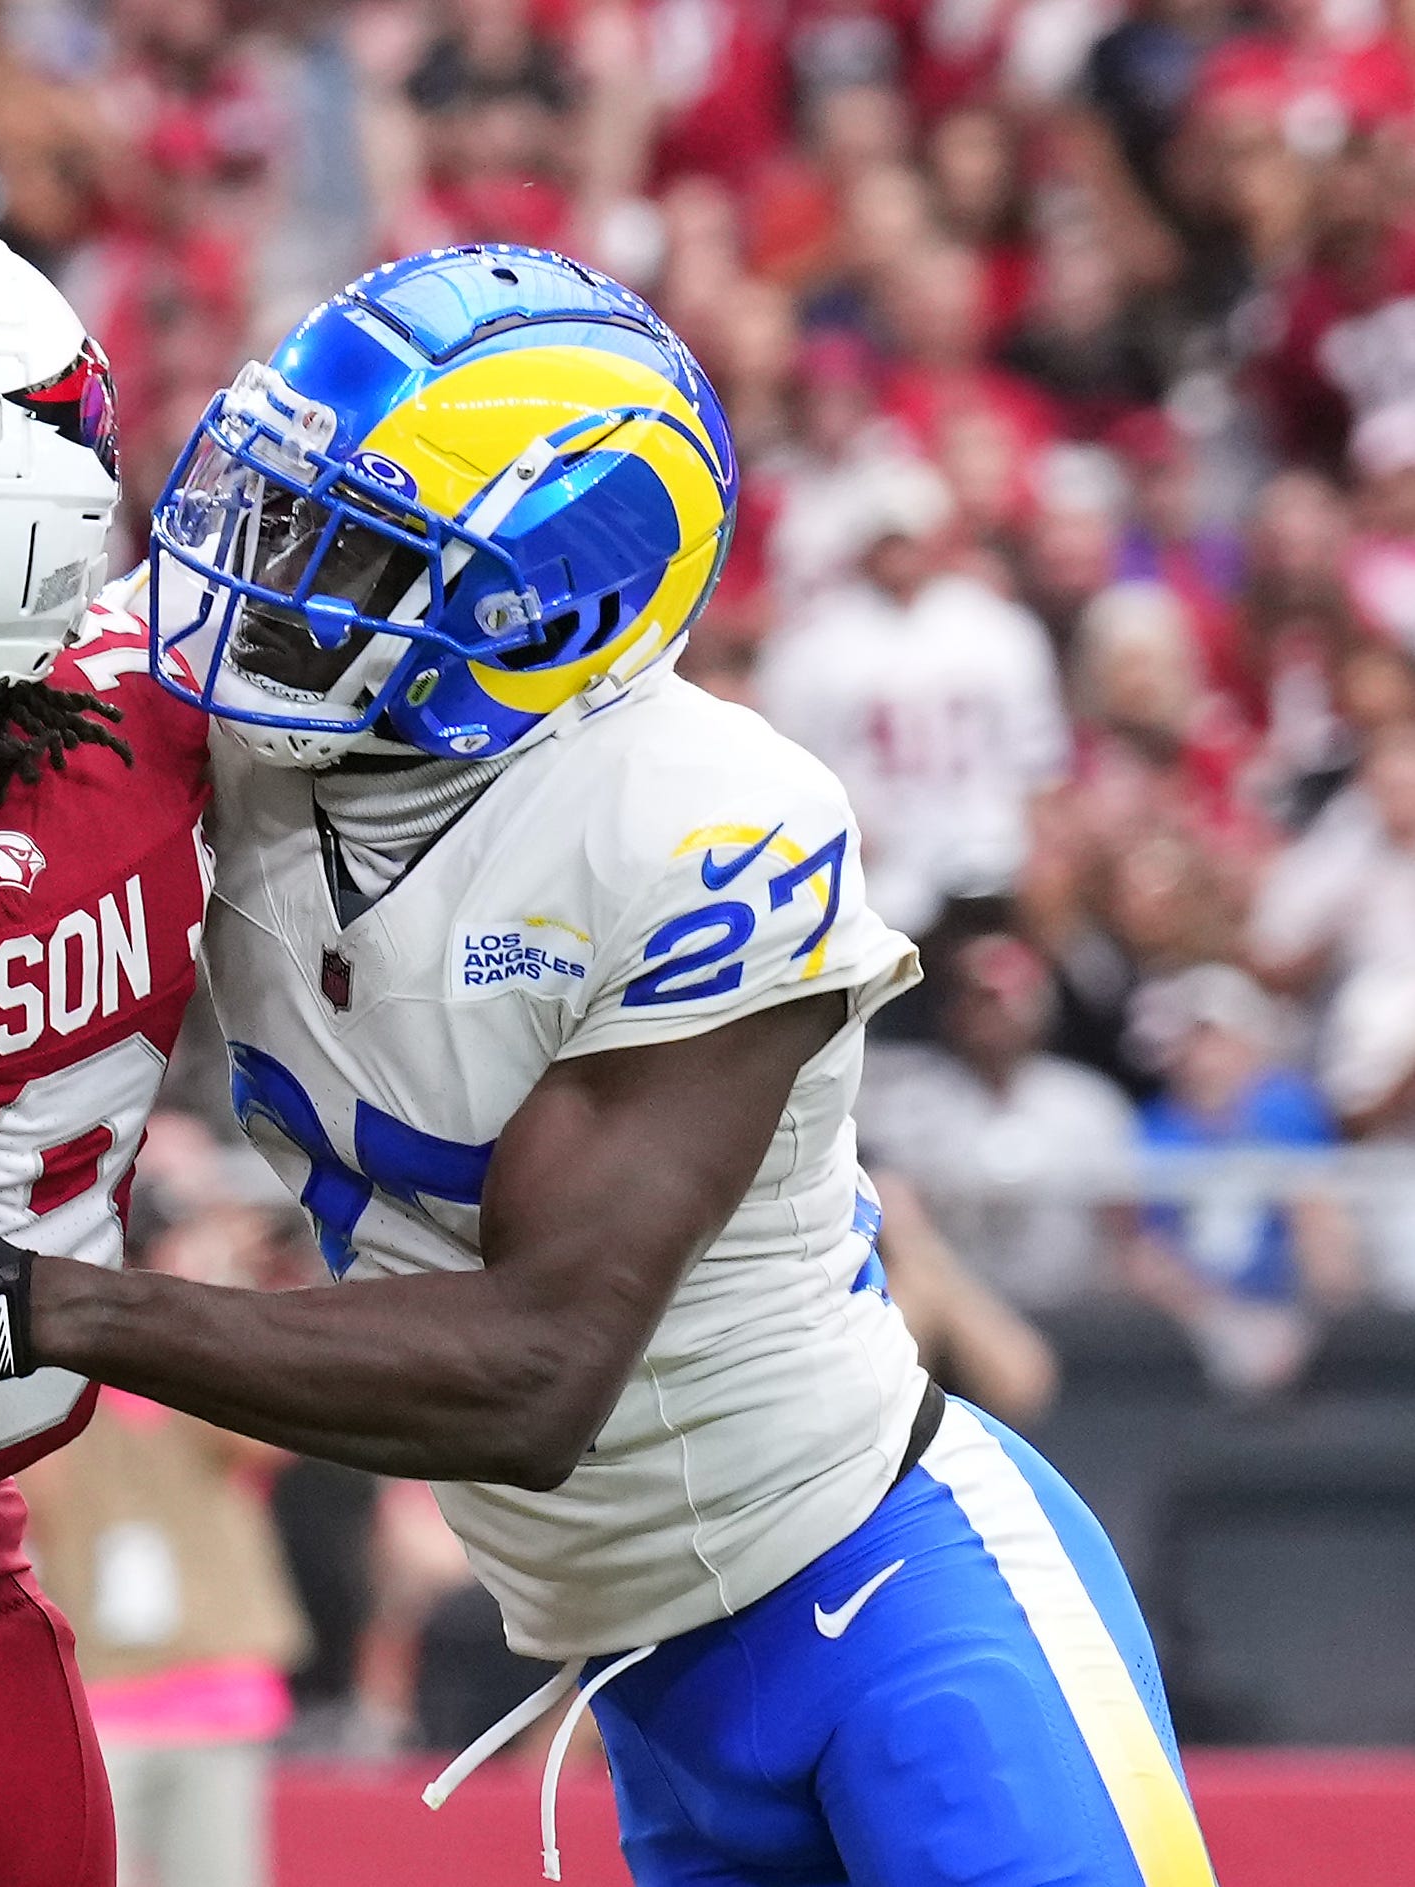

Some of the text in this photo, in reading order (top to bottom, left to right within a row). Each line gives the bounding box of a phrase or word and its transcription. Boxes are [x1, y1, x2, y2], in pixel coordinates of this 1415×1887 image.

[621, 828, 847, 1007] 27
[465, 933, 521, 951] LOS
[464, 962, 542, 985] RAMS
[465, 947, 585, 979] ANGELES
